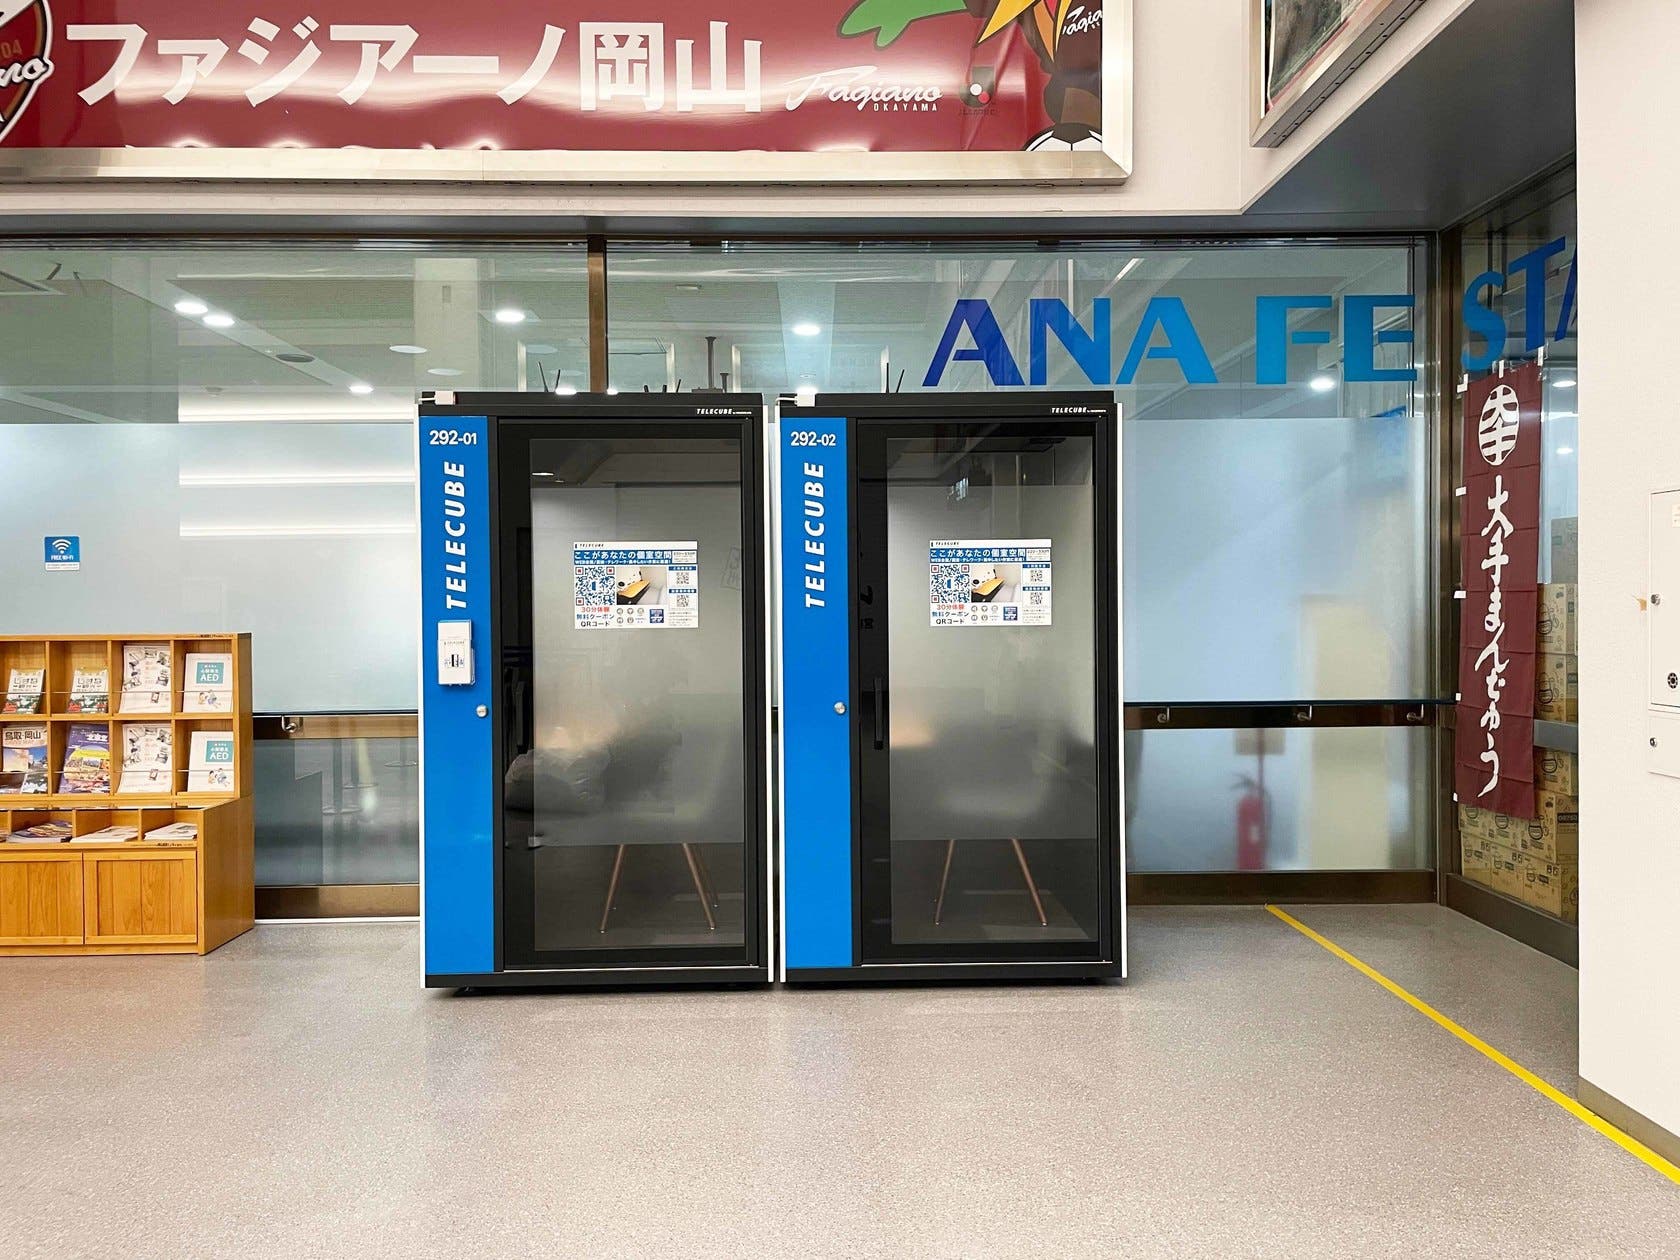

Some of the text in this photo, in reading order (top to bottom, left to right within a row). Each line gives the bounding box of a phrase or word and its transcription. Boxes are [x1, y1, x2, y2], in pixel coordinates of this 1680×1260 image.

[66, 15, 762, 112] ファジアーノ岡山
[785, 66, 943, 111] Fagiano
[873, 102, 939, 112] OKAYAMA
[923, 297, 1218, 386] ANA
[429, 430, 477, 446] 292-01
[790, 431, 837, 447] 292-02
[443, 461, 468, 610] TELECUBE
[803, 461, 827, 608] TELECUBE
[574, 551, 672, 560] ここがあなたの個室空間
[930, 549, 1026, 558] ここがあなたの個室空間
[936, 603, 965, 611] 30分体験
[580, 620, 611, 628] QRコード
[935, 617, 966, 625] QRコード
[200, 673, 219, 682] AED
[210, 751, 230, 760] AED
